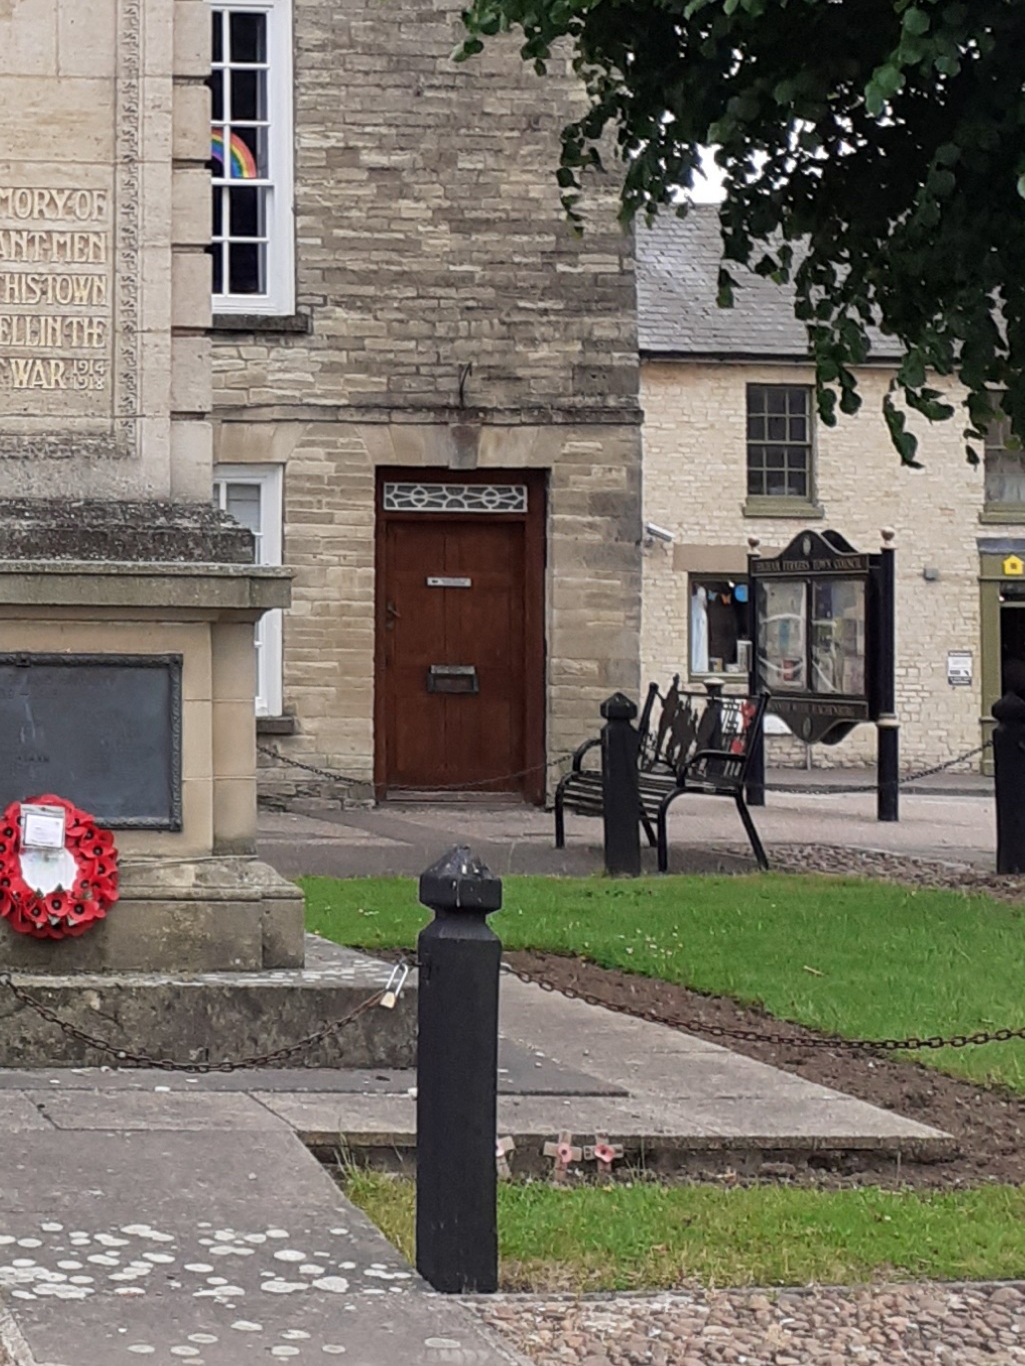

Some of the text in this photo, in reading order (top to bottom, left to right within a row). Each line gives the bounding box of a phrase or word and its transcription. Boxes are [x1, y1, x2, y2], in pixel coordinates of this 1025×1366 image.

[75, 190, 108, 221] OF
[51, 232, 108, 263] MEN
[43, 275, 108, 306] TOWN
[39, 317, 62, 348] IN
[65, 318, 107, 348] THE
[9, 359, 67, 389] WAR
[73, 359, 110, 375] 1914
